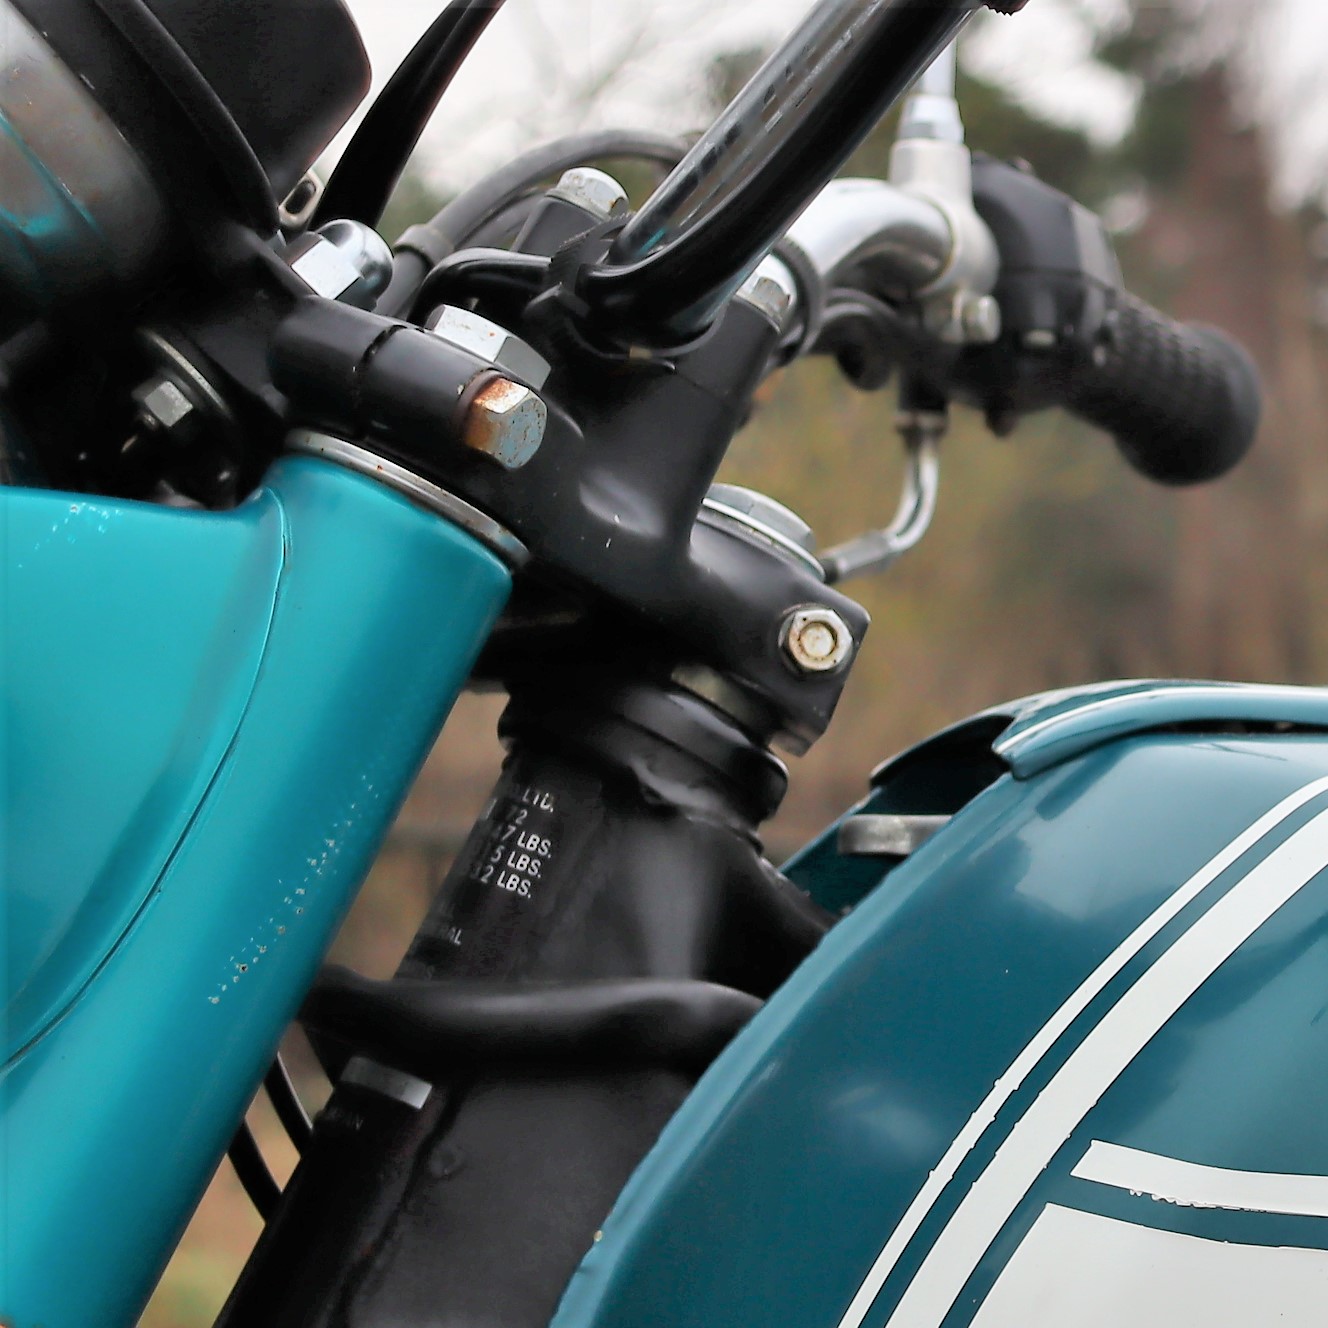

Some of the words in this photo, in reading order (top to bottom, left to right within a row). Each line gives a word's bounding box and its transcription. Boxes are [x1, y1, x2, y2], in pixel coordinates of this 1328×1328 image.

[517, 831, 552, 859] LBS.
[507, 851, 541, 879] LBS.
[497, 870, 531, 899] LBS.
